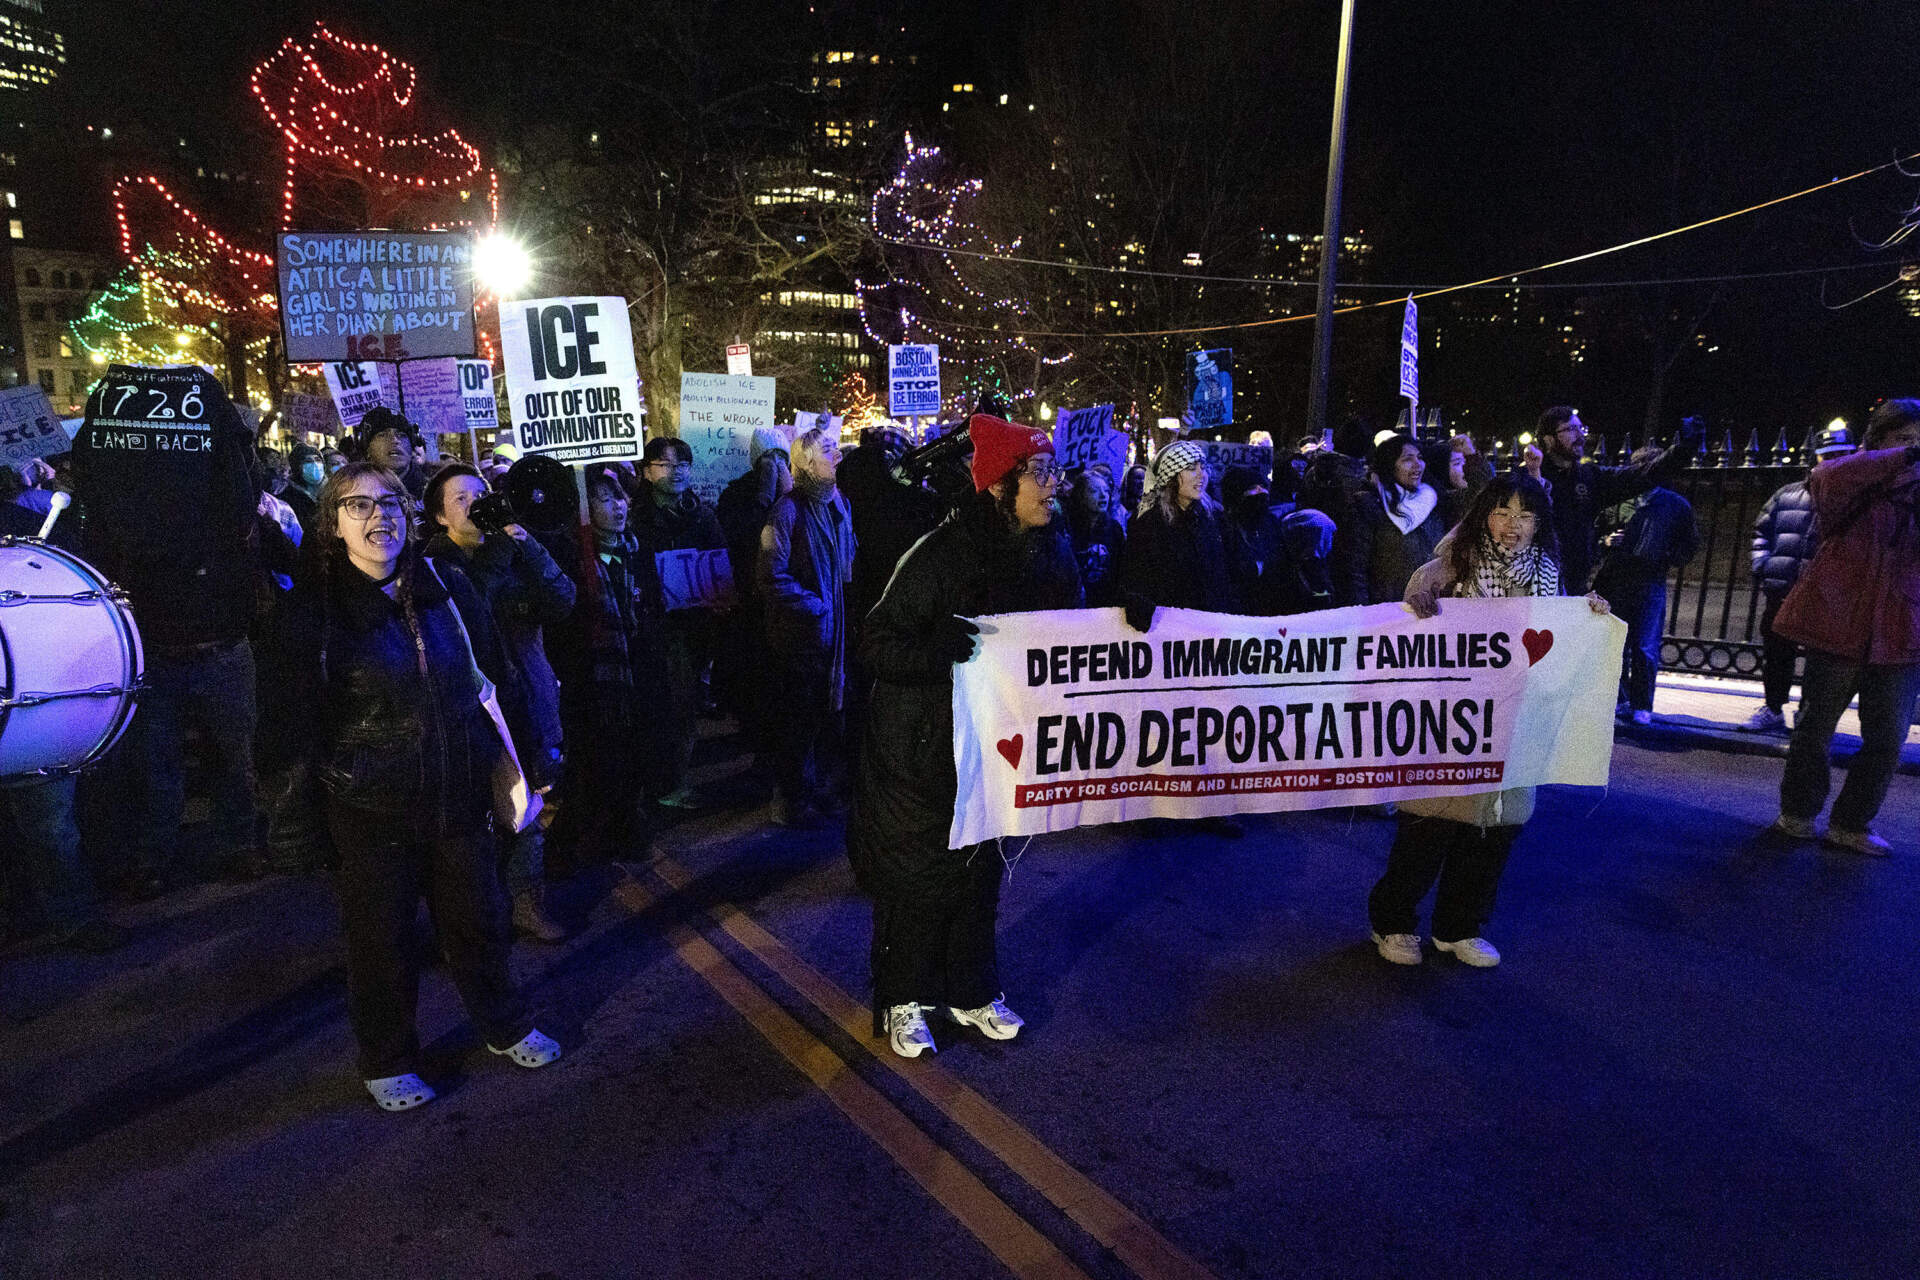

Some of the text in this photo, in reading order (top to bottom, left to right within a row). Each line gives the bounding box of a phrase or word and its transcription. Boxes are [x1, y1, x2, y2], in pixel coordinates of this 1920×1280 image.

[283, 234, 471, 266] SOMEWHERE IN AN
[358, 266, 376, 289] A
[381, 266, 453, 292] LITTLE
[287, 290, 457, 316] GIRL IS WRITING IN
[288, 311, 466, 337] HER DIARY ABOUT
[526, 303, 607, 381] ICE
[895, 351, 932, 366] BOSTON
[334, 361, 371, 391] ICE
[457, 362, 490, 396] TOP
[685, 377, 757, 391] ABOLISH ICE
[892, 366, 937, 378] MINNEAPOLIS
[340, 389, 380, 407] OUT OF OUR
[893, 380, 938, 391] STOP
[893, 390, 939, 405] ICE TERROR
[97, 382, 204, 420] 1726
[464, 396, 494, 410] ERROR
[525, 386, 622, 420] OUT OF OUR
[683, 393, 769, 407] ABOLISH BILLIONAIRES
[520, 412, 636, 449] COMMUNITIES
[688, 411, 764, 426] THE WRONG
[1067, 408, 1110, 443] FUCK
[91, 432, 212, 452] LAND BACK
[707, 427, 737, 440] ICE
[557, 446, 592, 460] SOCIALISM
[592, 446, 600, 456] &
[600, 444, 637, 456] LIBERATION
[708, 446, 749, 457] MELTIN
[1064, 437, 1100, 468] ICE
[1205, 444, 1272, 465] BOLISH
[1026, 632, 1513, 687] DEFEND IMMIGRANT FAMILIES
[1036, 698, 1494, 776] END DEPORTATIONS!
[1026, 786, 1073, 803] PARTY
[1078, 783, 1106, 797] FOR
[1110, 779, 1193, 793] SOCIALISM
[1196, 777, 1227, 792] AND
[1230, 773, 1320, 791] LIBERATION
[1336, 770, 1394, 786] BOSTON
[1405, 766, 1501, 784] @BOSTONPSL
